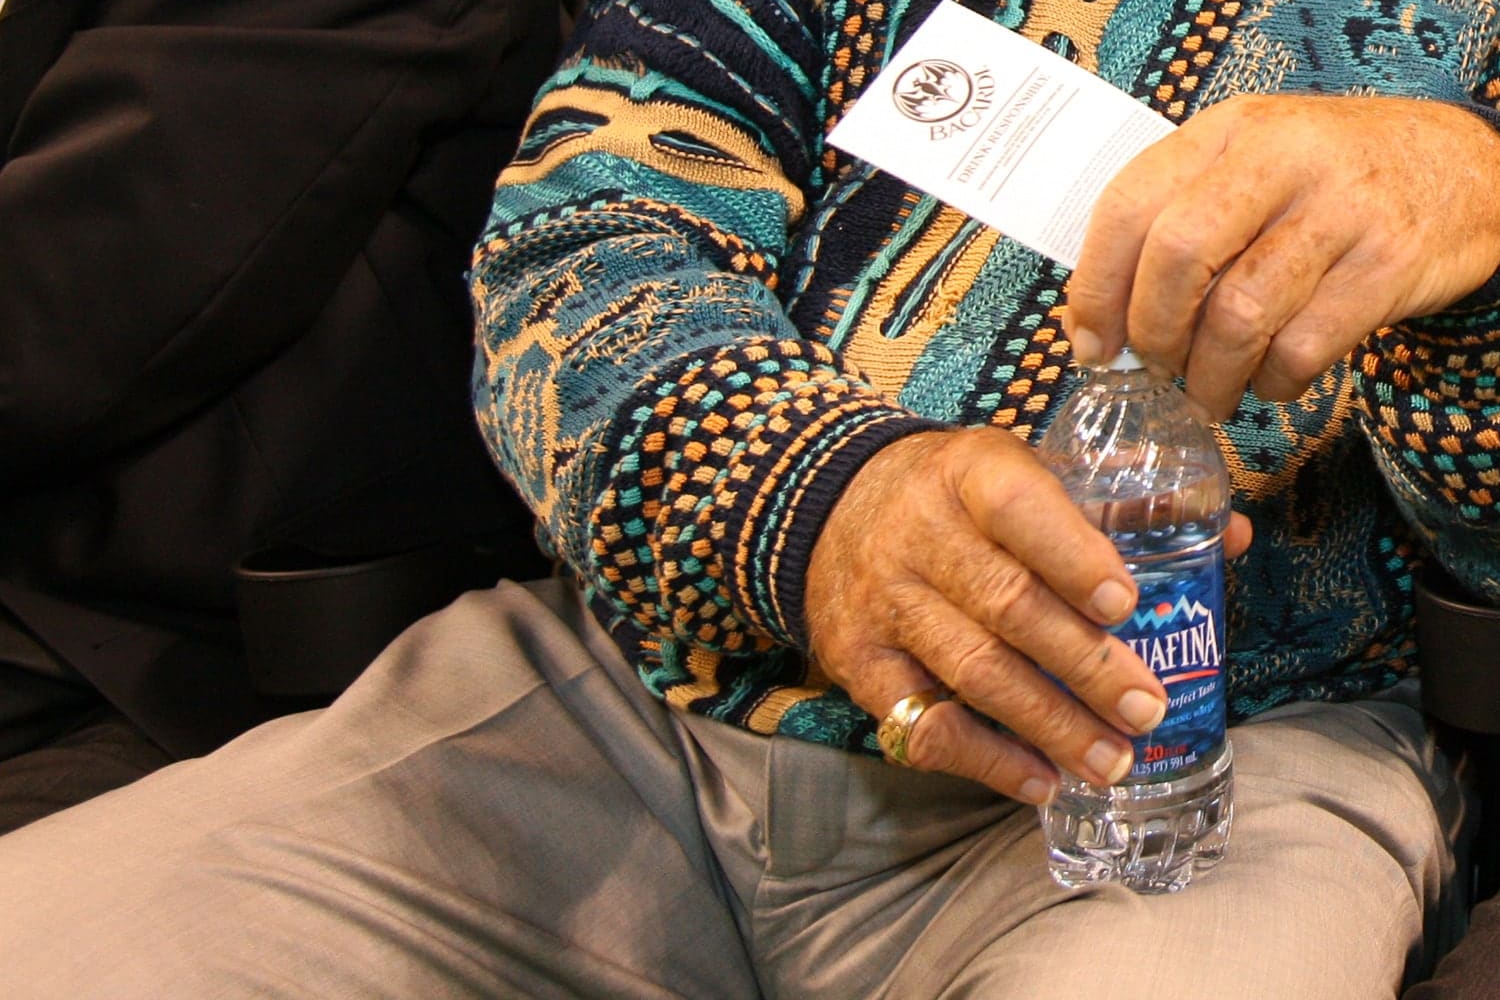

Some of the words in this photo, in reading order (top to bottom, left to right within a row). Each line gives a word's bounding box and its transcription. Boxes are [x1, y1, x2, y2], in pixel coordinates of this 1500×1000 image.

[929, 68, 996, 141] BACARDI
[957, 145, 993, 184] DRINK
[1126, 609, 1219, 672] UAFINA
[1143, 745, 1164, 762] 20
[1170, 755, 1183, 768] 591
